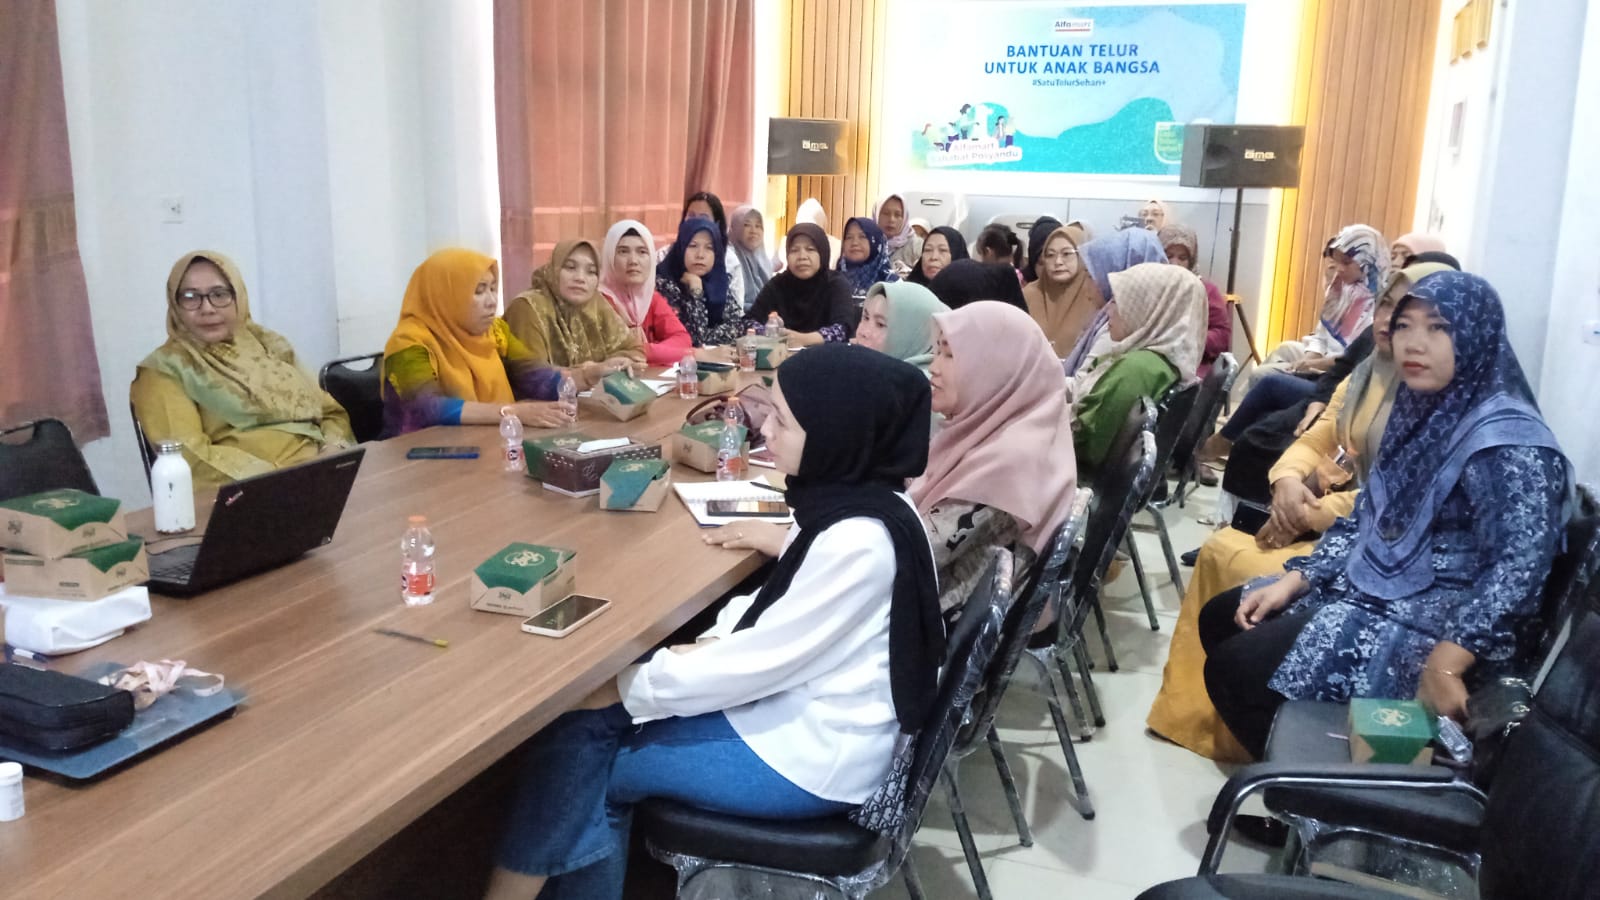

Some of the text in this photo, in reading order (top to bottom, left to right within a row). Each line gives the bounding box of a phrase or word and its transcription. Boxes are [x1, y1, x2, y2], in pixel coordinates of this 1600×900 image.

[1007, 44, 1139, 57] BANTUAN TELUR
[984, 61, 1160, 74] UNTUK ANAK BANGSA
